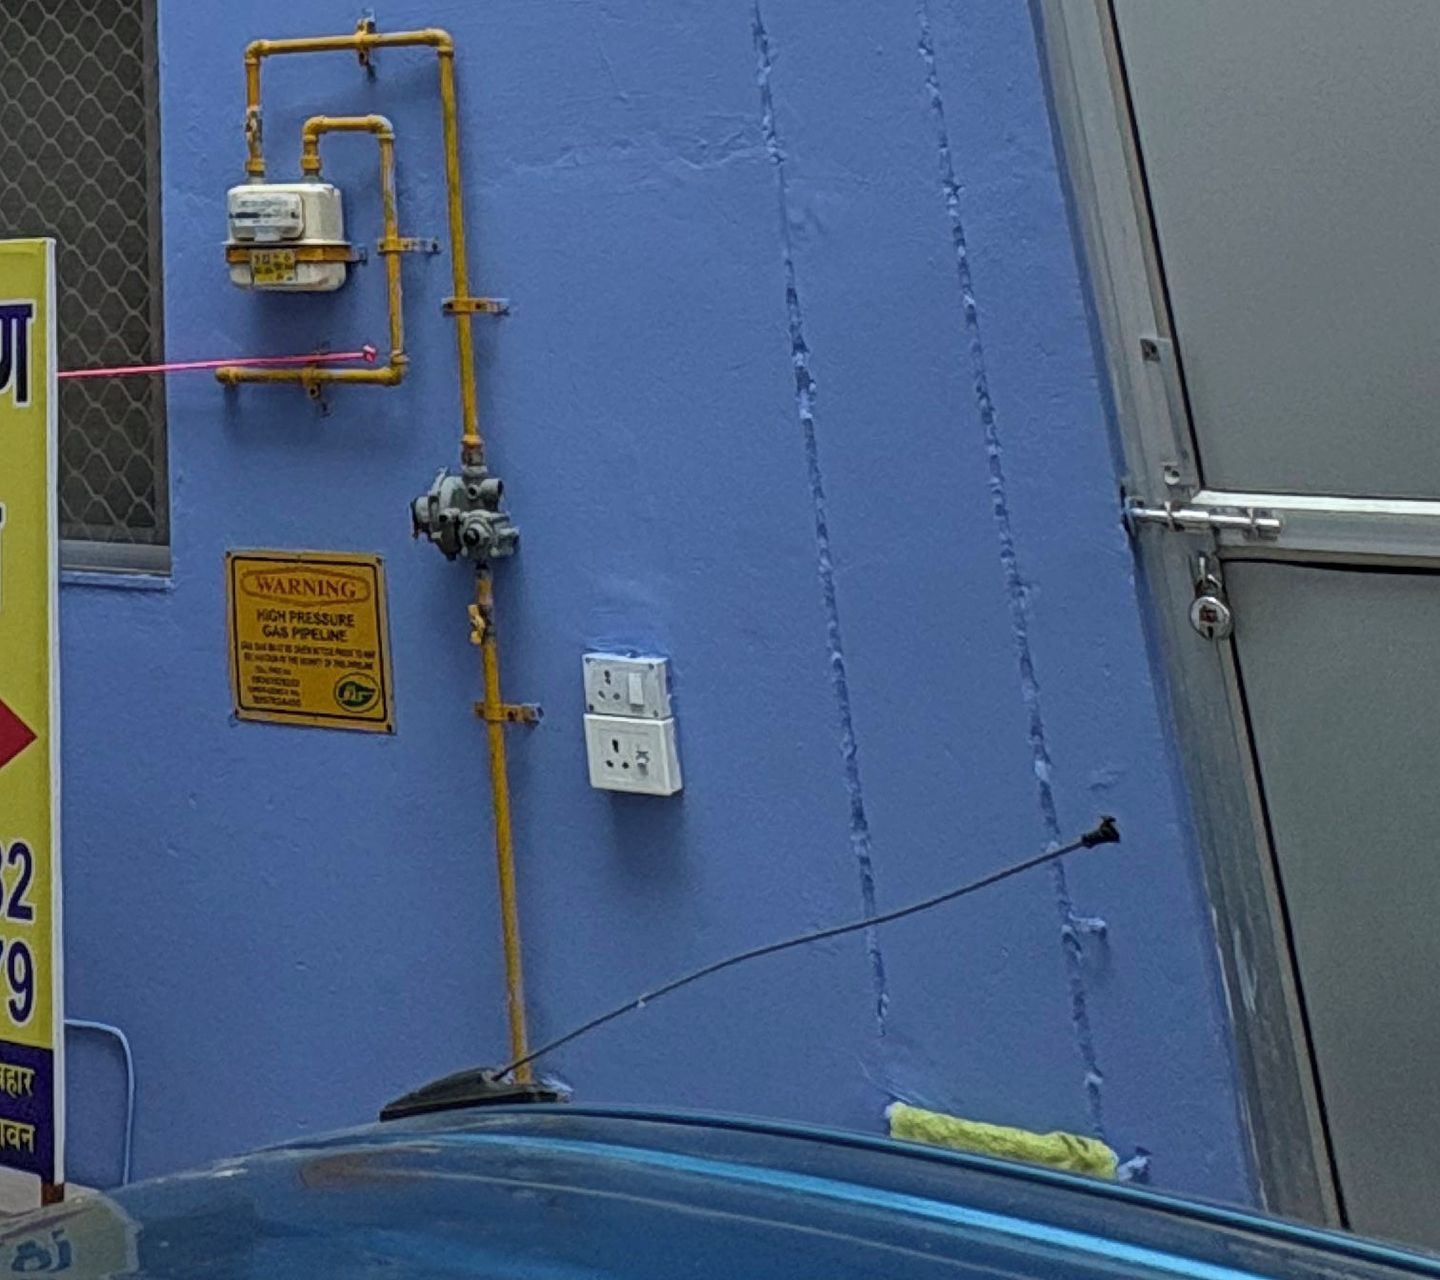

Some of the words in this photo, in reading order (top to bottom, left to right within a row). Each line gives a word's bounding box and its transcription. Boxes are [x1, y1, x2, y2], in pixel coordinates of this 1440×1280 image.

[255, 575, 357, 599] WARNING
[257, 608, 286, 623] HIGH
[289, 610, 355, 628] PRESSURE
[262, 624, 289, 639] GAS
[292, 626, 349, 643] PIPELINE
